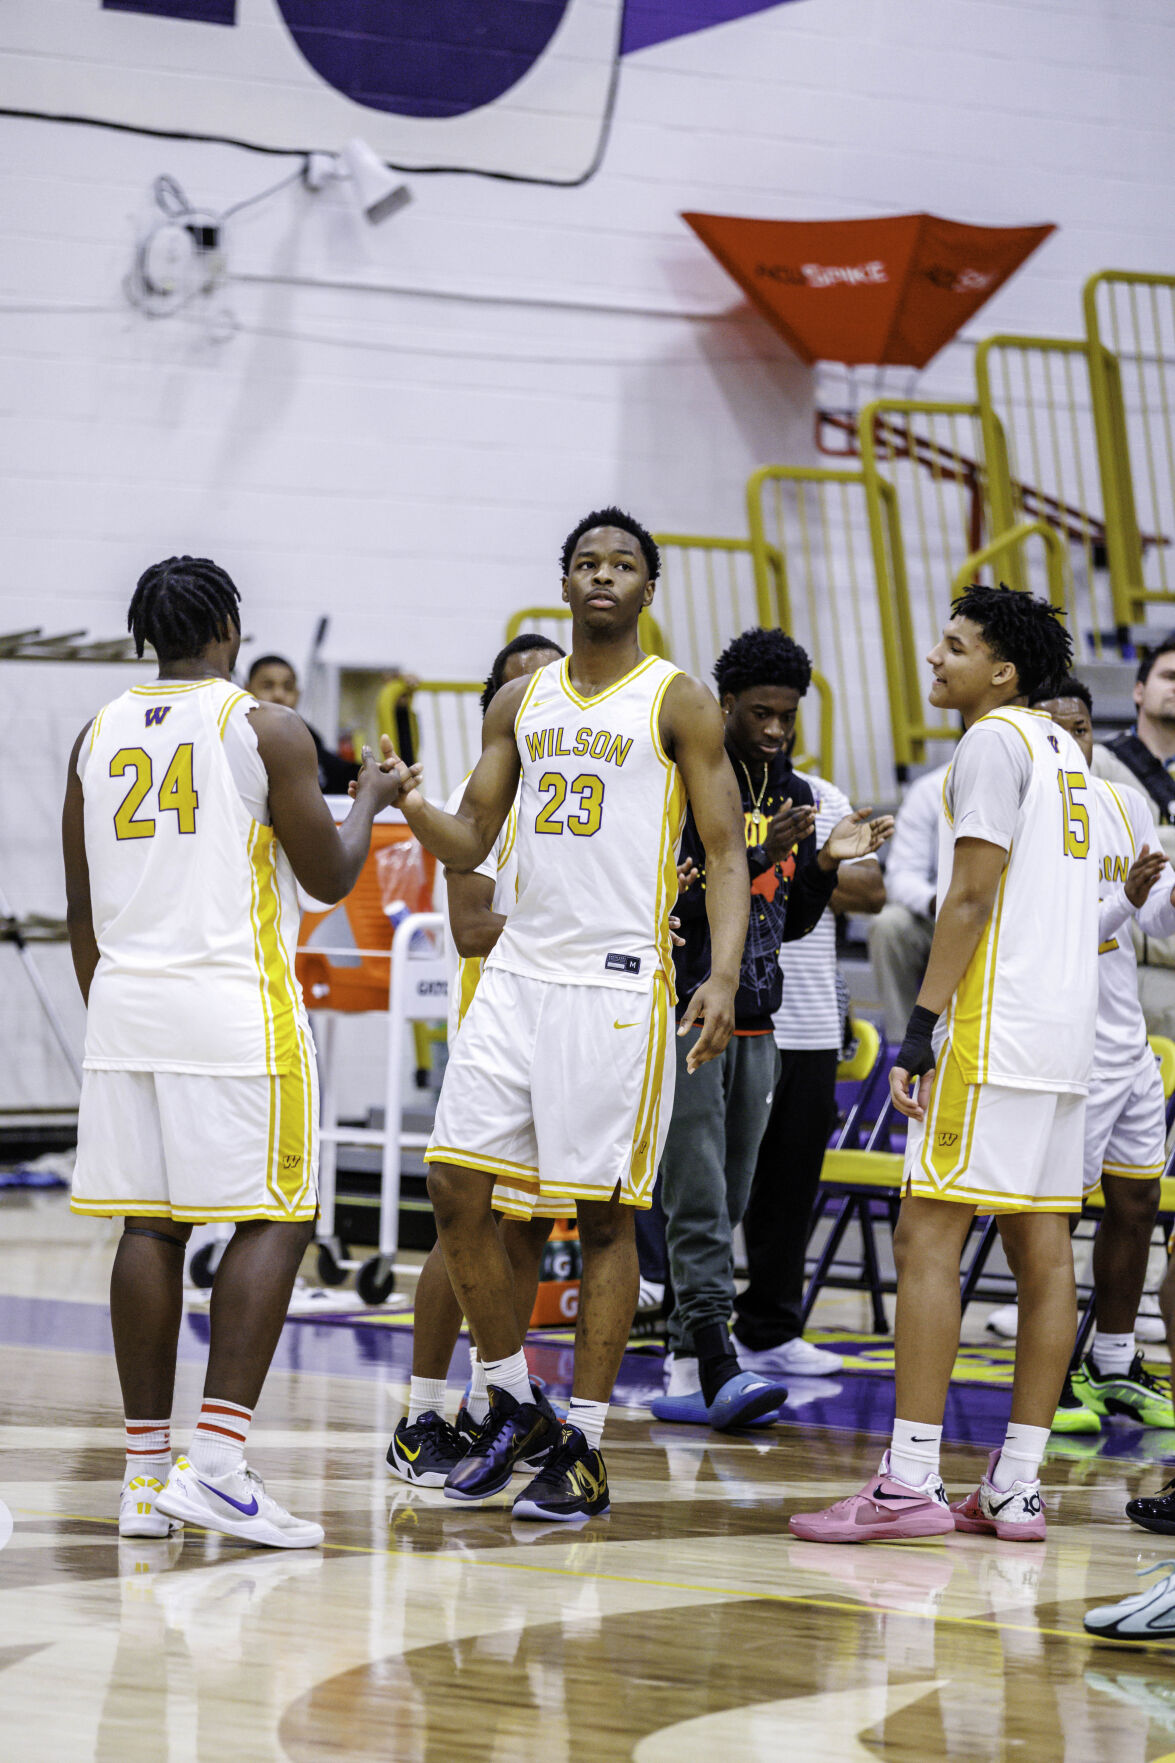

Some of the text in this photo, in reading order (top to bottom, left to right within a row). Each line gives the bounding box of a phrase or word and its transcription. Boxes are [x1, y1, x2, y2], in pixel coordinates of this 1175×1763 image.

[144, 706, 172, 728] W
[524, 727, 634, 768] WILSON
[109, 742, 199, 841] 24
[535, 772, 605, 837] 23
[1057, 768, 1090, 860] 15
[629, 961, 637, 969] M
[938, 1132, 958, 1147] W
[283, 1154, 301, 1169] W
[553, 1255, 572, 1278] G
[560, 1288, 579, 1318] G
